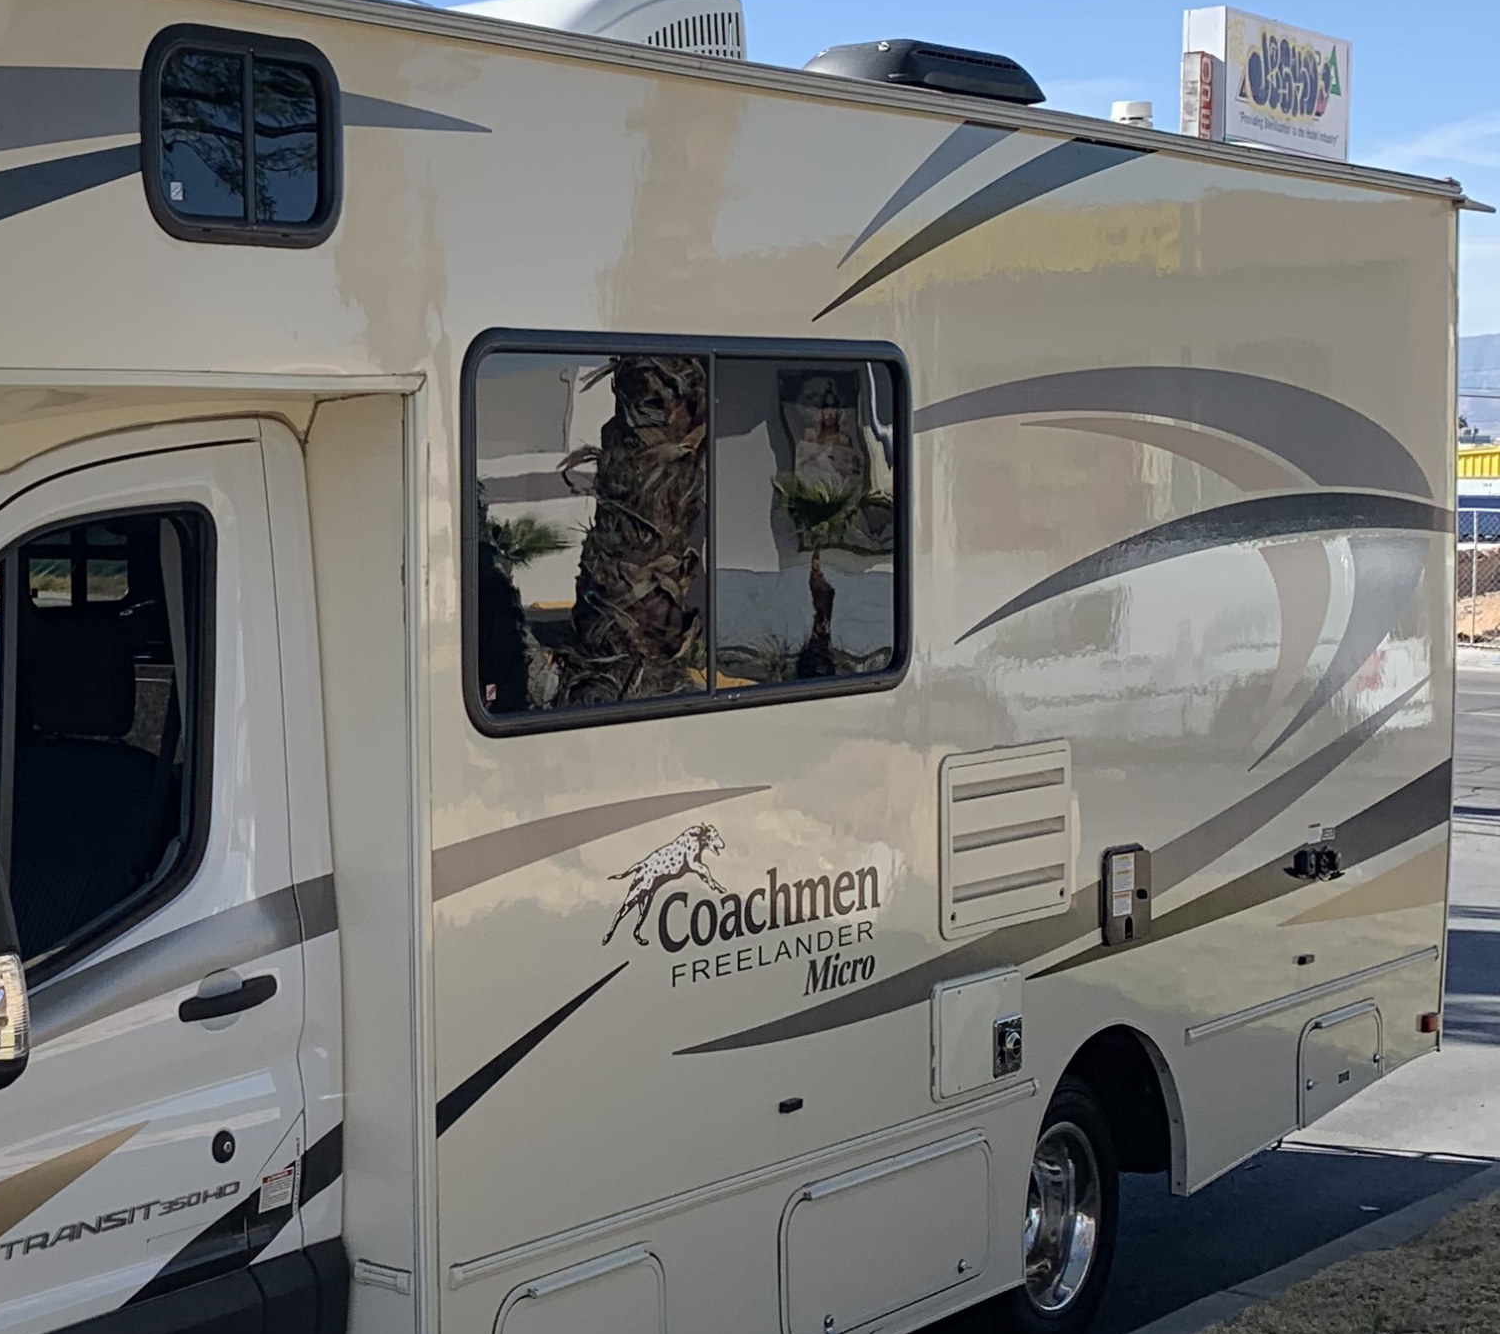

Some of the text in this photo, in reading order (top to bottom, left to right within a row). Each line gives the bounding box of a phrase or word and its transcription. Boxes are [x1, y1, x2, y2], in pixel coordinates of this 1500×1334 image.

[658, 866, 881, 953] Coachmen
[672, 920, 874, 988] FREELANDER
[803, 952, 876, 997] Micro
